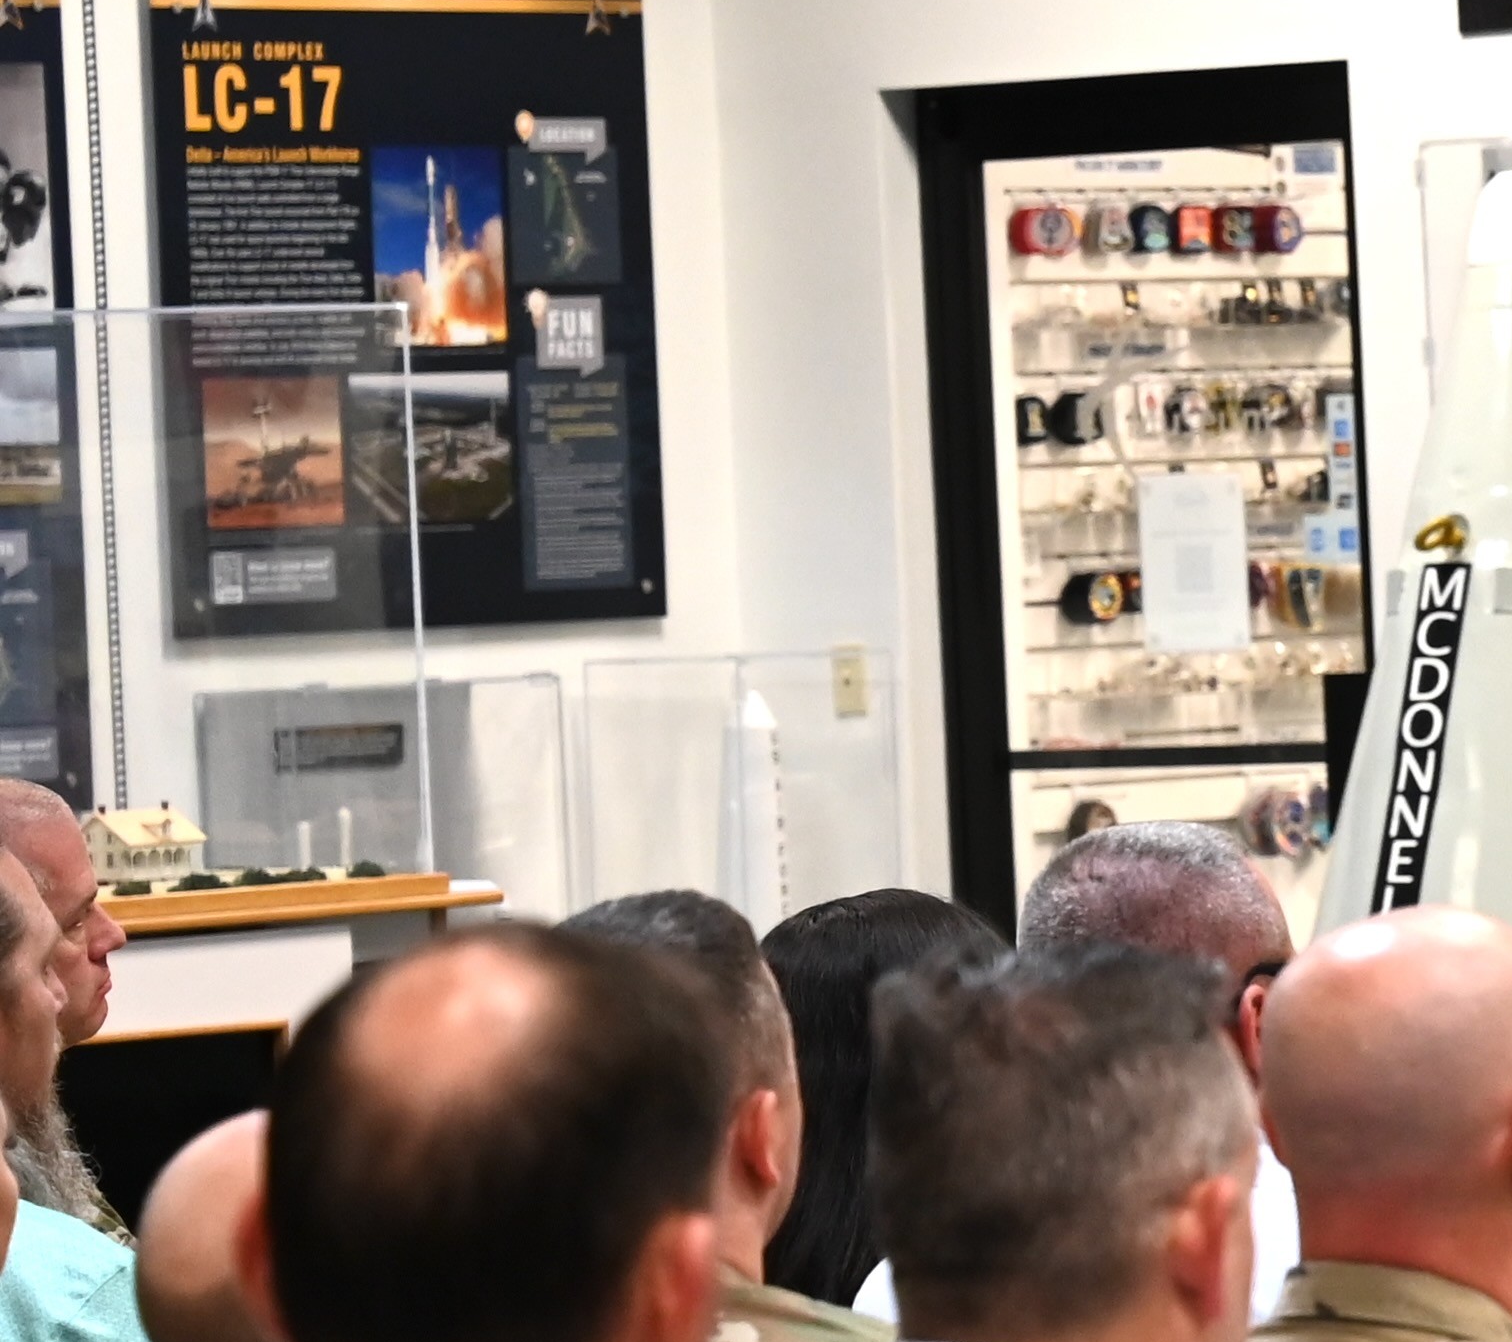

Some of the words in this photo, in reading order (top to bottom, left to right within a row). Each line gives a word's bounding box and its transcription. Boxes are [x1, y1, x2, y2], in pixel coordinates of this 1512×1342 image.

[182, 41, 242, 61] LAUNCH
[253, 41, 324, 61] COMPLEX
[183, 62, 342, 133] LC-17
[547, 309, 594, 338] FUN
